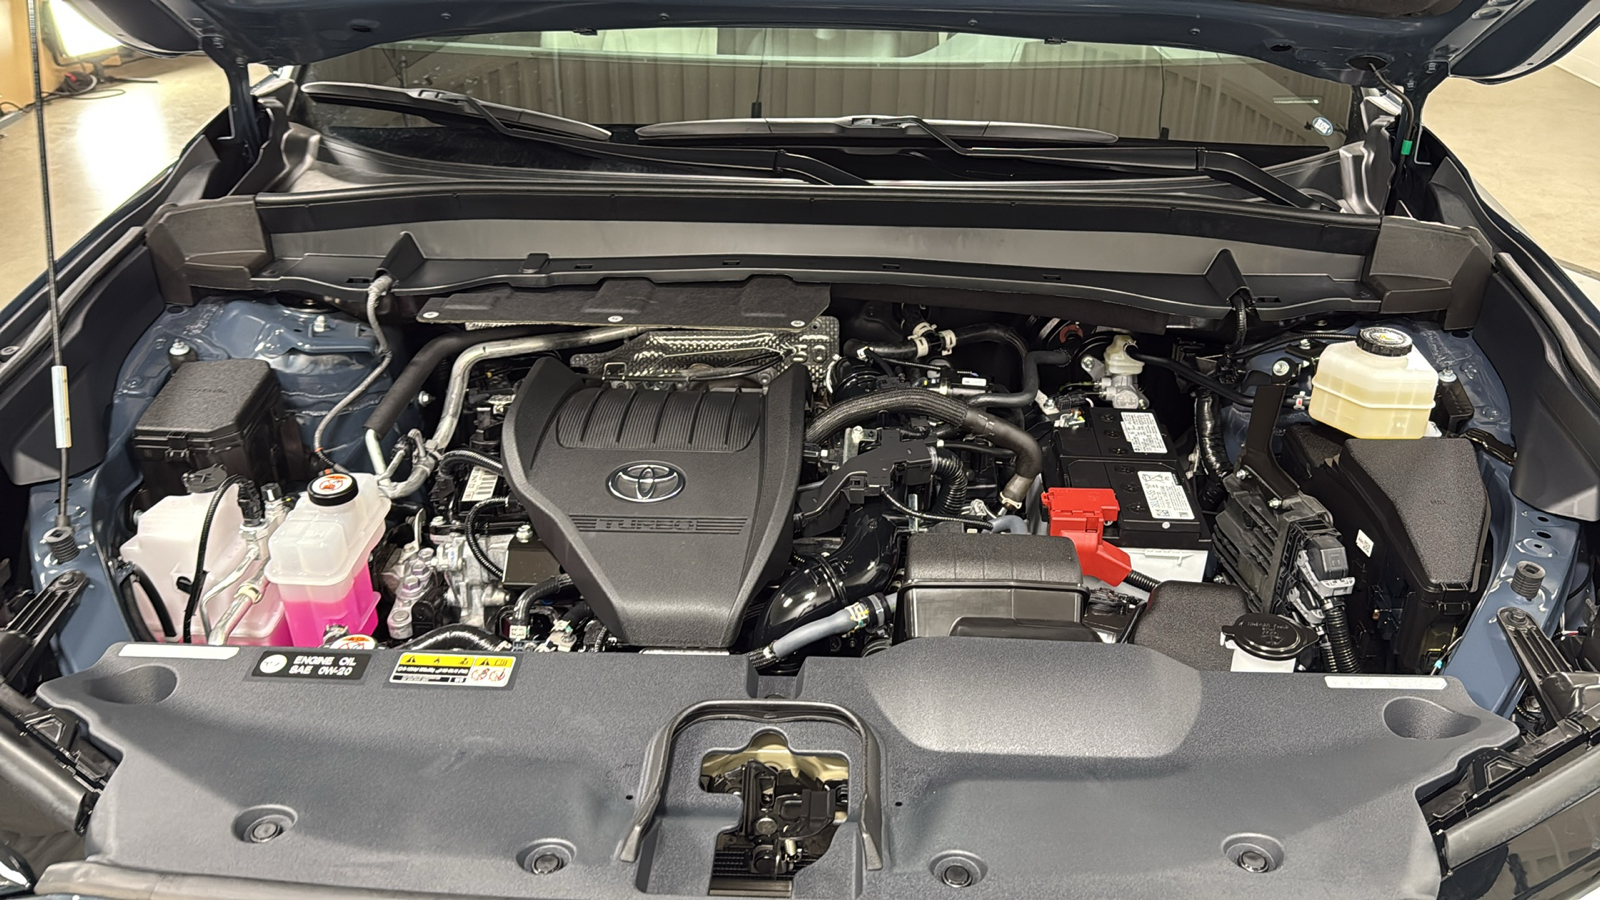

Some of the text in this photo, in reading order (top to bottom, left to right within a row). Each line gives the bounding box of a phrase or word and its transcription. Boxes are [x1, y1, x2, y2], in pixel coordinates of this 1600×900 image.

[599, 519, 694, 530] TURBO
[293, 655, 357, 666] ENGINE OIL
